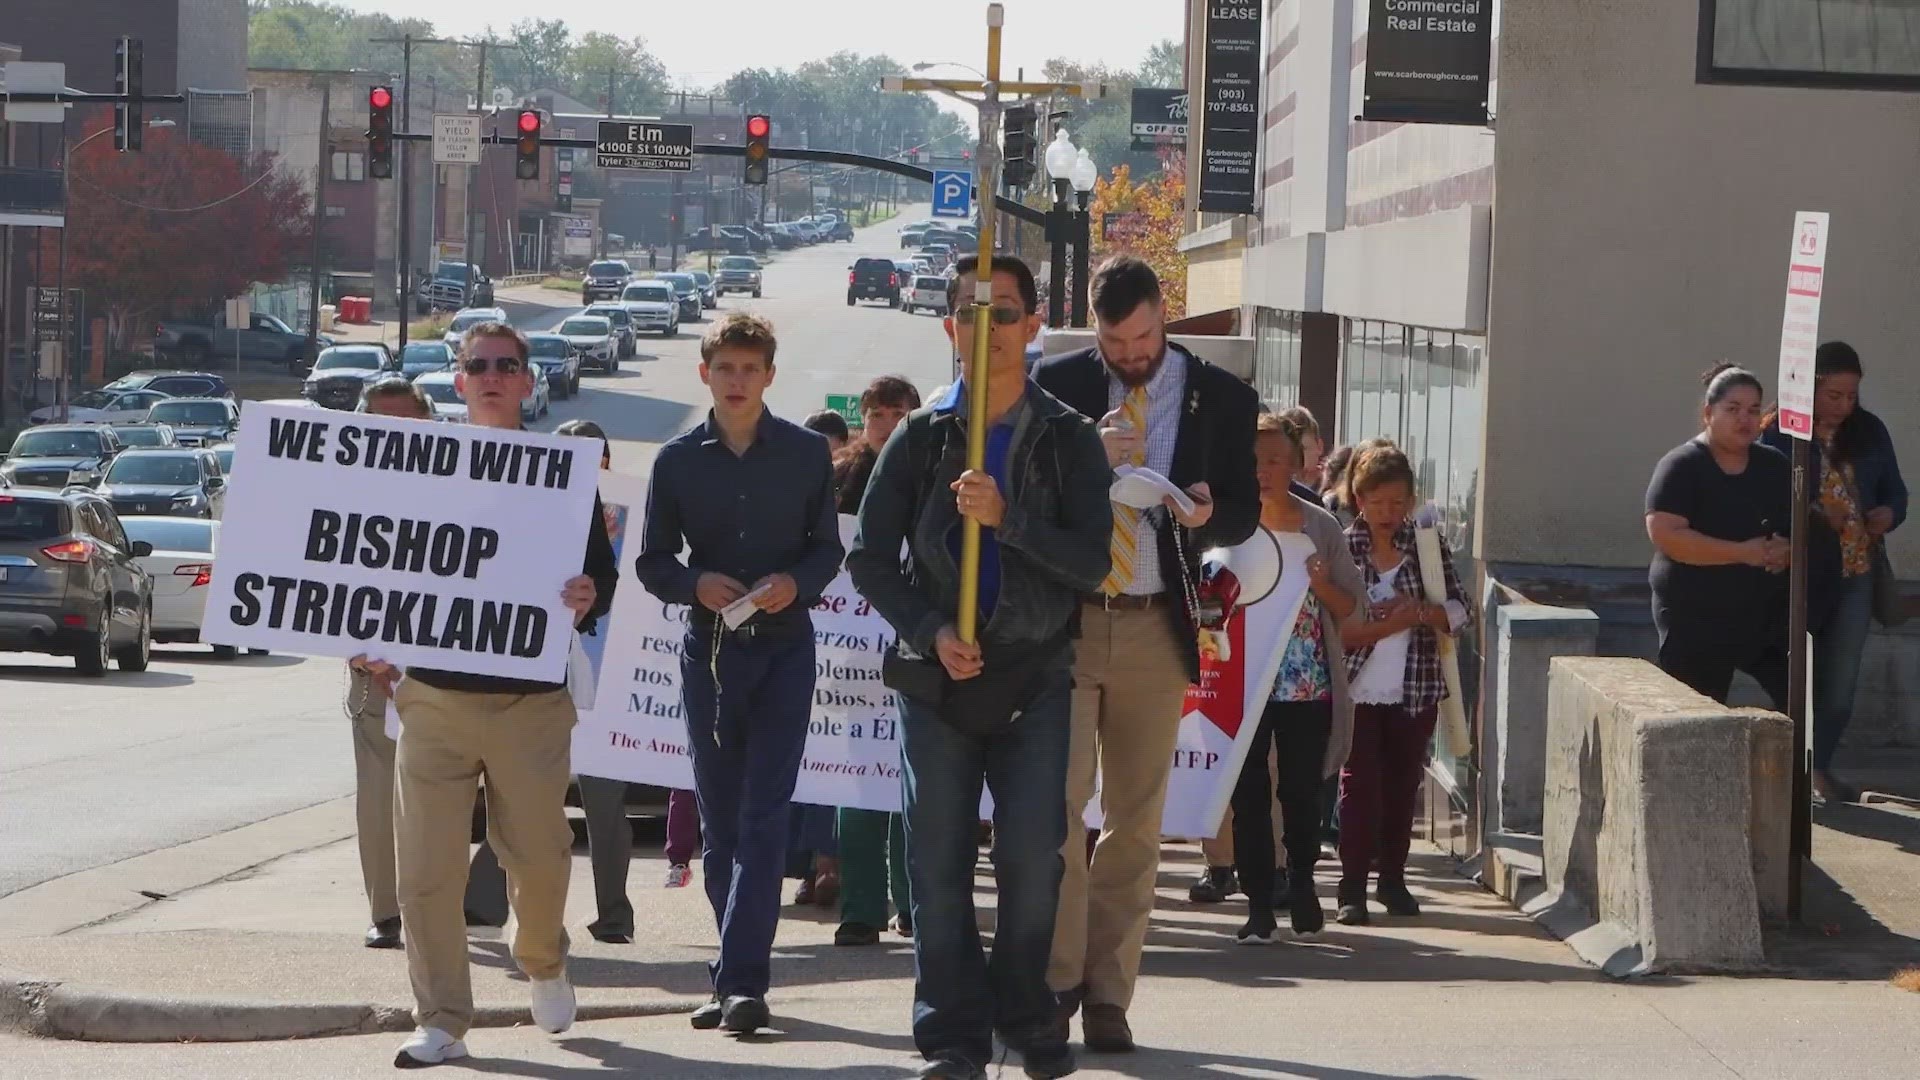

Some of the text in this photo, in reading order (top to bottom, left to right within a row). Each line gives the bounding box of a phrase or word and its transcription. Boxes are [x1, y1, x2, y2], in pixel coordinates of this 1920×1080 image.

[1211, 7, 1257, 20] LEASE
[1385, 0, 1480, 14] Commercial
[1387, 15, 1477, 33] Real Estate
[1374, 70, 1479, 82] www.scarboroughcre.com
[1218, 88, 1245, 101] (903)
[1207, 101, 1255, 113] 707-8561
[627, 125, 663, 142] Elm
[1146, 125, 1167, 133] OFF
[606, 143, 684, 156] 100E St 100W
[1206, 149, 1253, 159] Scarborough
[600, 157, 623, 167] Tyler
[663, 159, 690, 169] Texas
[1207, 158, 1252, 166] Commercial
[1208, 165, 1250, 174] Real Estate
[943, 183, 962, 205] P
[268, 416, 574, 490] WE STAND WITH
[304, 508, 499, 579] BISHOP
[230, 571, 549, 659] STRICKLAND
[633, 666, 674, 687] nos
[815, 688, 876, 708] Dios,
[850, 723, 863, 738] a
[609, 730, 641, 750] The
